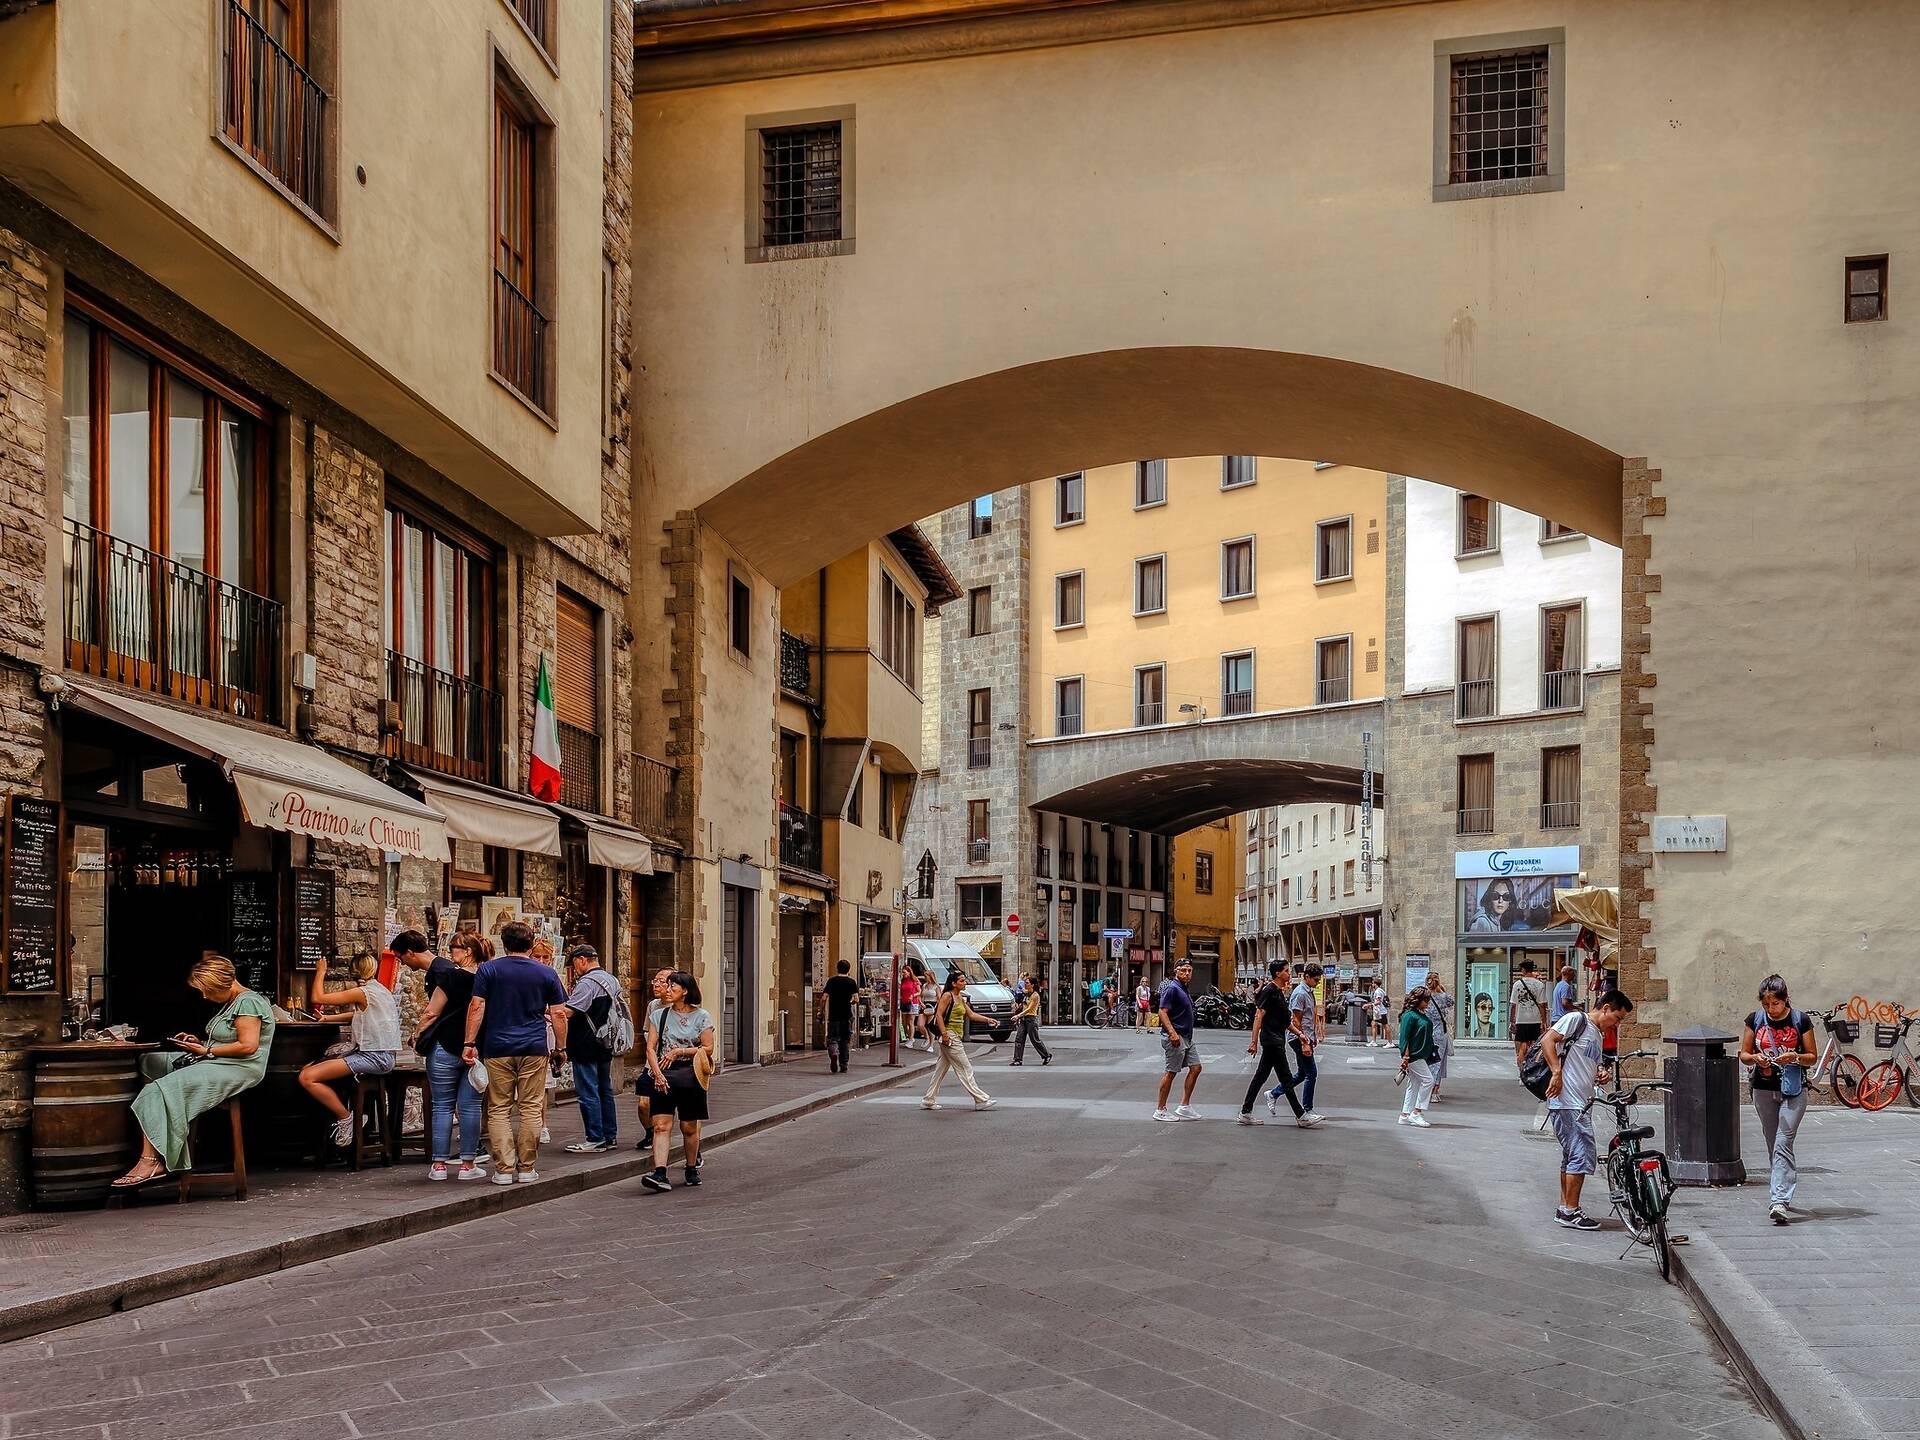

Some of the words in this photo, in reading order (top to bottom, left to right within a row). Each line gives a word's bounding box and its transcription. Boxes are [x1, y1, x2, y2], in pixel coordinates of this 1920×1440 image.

[268, 801, 279, 818] il
[282, 791, 349, 836] Panino
[350, 819, 366, 837] del
[369, 816, 422, 852] Chianti
[1684, 836, 1715, 844] BARDI
